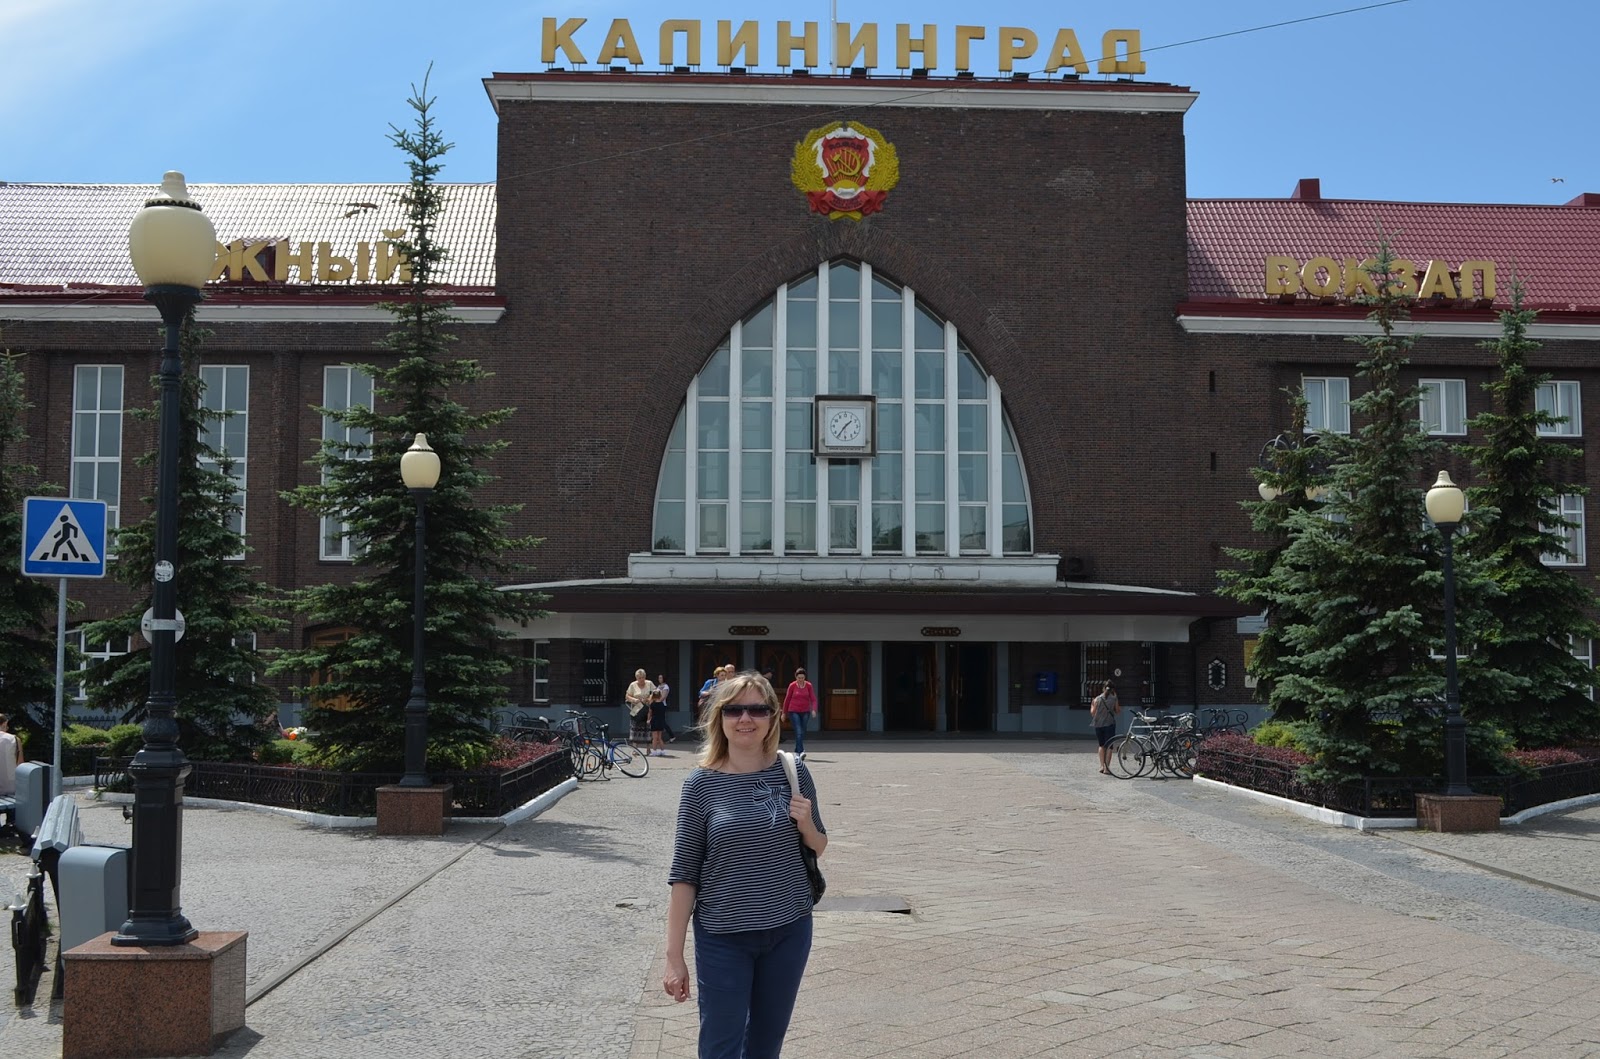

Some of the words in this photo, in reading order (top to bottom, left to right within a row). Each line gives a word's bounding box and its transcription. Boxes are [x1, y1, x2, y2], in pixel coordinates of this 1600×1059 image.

[541, 17, 1147, 74] КАЛИНИНГРАД
[209, 229, 413, 282] ЖНЫЙ
[1265, 256, 1496, 299] ВОКЗАЛ
